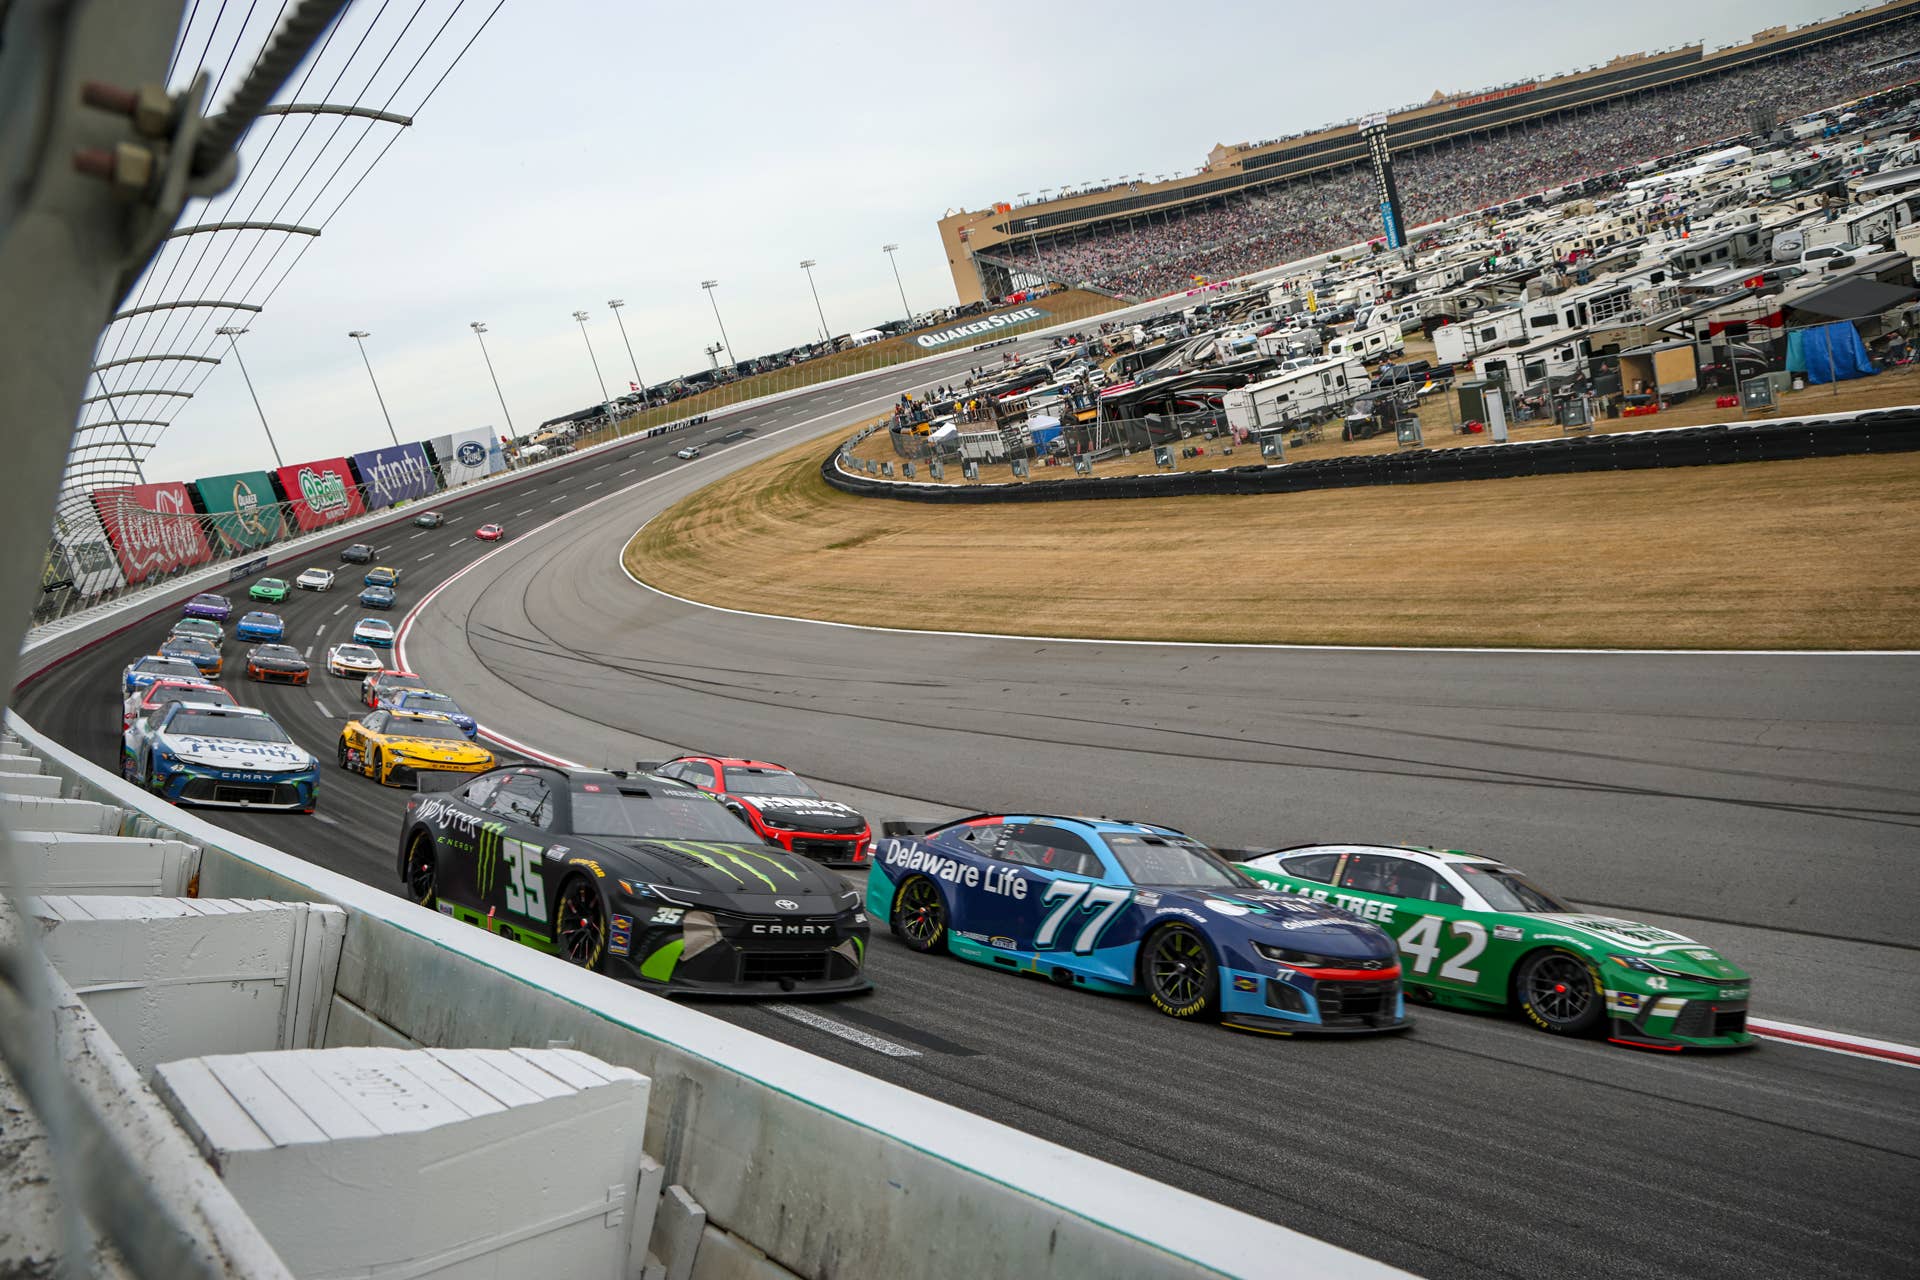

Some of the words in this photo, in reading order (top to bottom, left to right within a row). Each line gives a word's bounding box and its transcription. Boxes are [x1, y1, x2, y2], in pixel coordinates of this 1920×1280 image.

[1457, 96, 1482, 108] ATLANTA
[1485, 92, 1505, 101] MOTOR
[917, 320, 994, 347] QUAKER
[988, 307, 1040, 328] STATE
[299, 469, 347, 512] O'Reilly
[366, 450, 426, 500] xfinity
[191, 743, 301, 761] Health
[221, 772, 273, 781] CAMRY
[502, 837, 548, 923] 35
[885, 839, 979, 888] Delaware
[984, 864, 1028, 900] Life
[650, 906, 686, 924] 35
[1035, 879, 1134, 953] 77
[1333, 893, 1398, 924] TREE
[752, 924, 831, 935] CAMRY
[1396, 914, 1488, 984] 42
[1276, 968, 1296, 981] 77
[1645, 977, 1669, 990] 42
